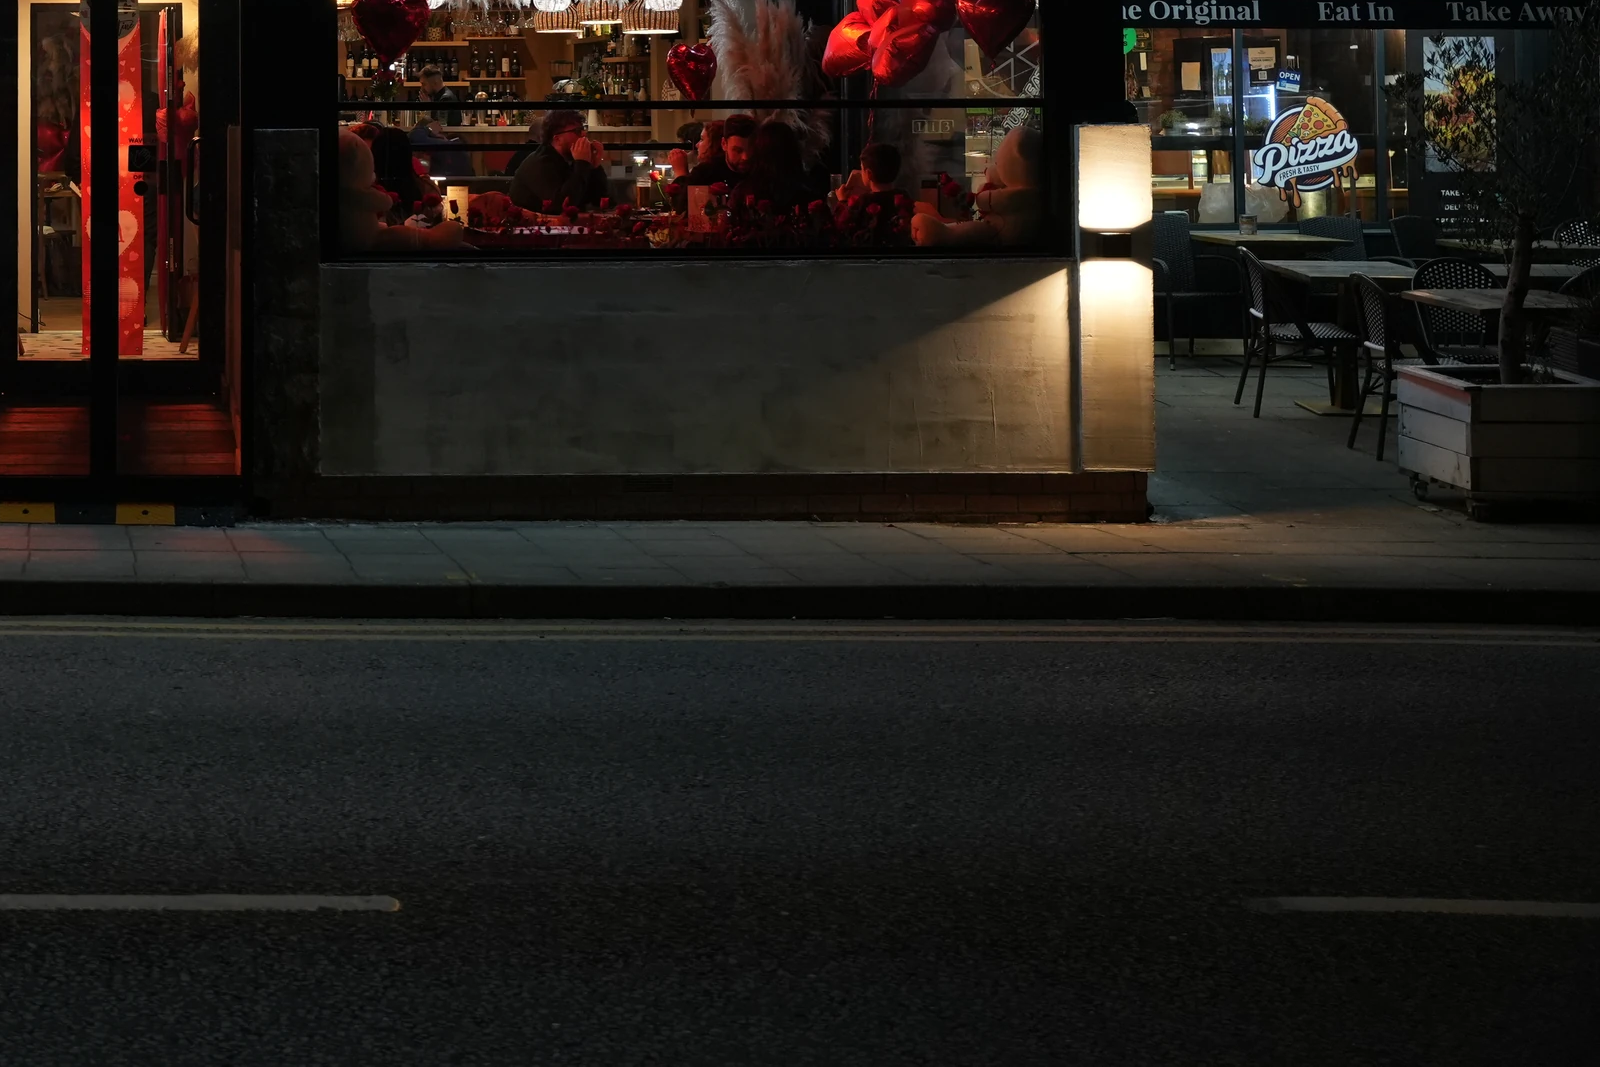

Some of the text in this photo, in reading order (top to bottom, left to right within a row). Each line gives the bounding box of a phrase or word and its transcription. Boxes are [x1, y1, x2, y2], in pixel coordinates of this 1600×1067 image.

[1317, 1, 1395, 22] Eat In
[1446, 0, 1511, 22] Take
[1279, 71, 1301, 82] OPEN
[1253, 129, 1360, 184] Pizza
[1279, 168, 1297, 182] FRESH
[1303, 164, 1320, 175] TASTY
[1440, 189, 1461, 197] TAKE
